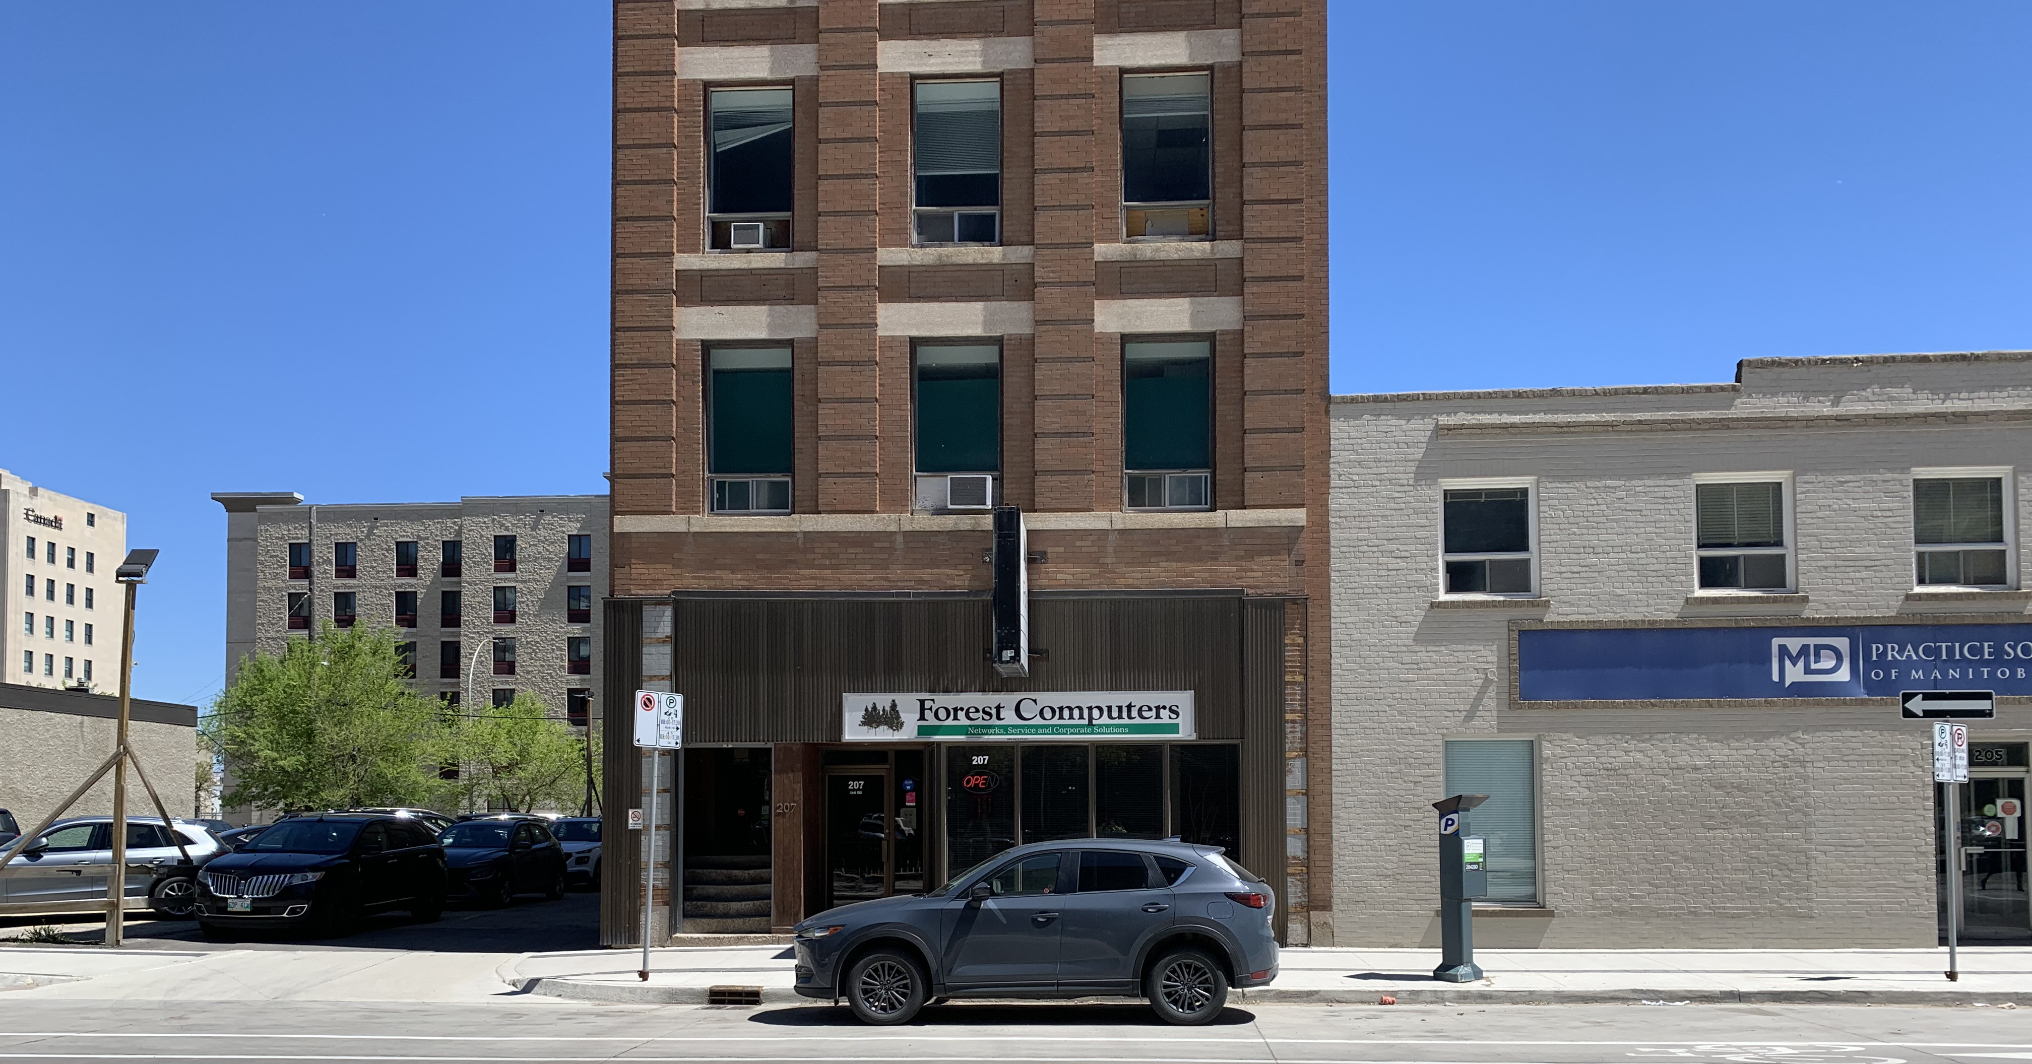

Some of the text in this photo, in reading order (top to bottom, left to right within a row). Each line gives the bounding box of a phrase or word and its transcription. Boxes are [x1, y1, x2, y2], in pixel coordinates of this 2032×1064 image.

[1871, 641, 1995, 661] PRACTICE
[1778, 643, 1845, 682] MD
[1871, 667, 2026, 680] OF MANITOB
[916, 697, 1180, 727] Forest Computers
[968, 725, 1129, 735] Networks, Service and Corporate Solutions
[971, 755, 989, 765] 207
[1974, 748, 2004, 762] 205
[848, 781, 864, 789] 207
[776, 802, 797, 813] 207
